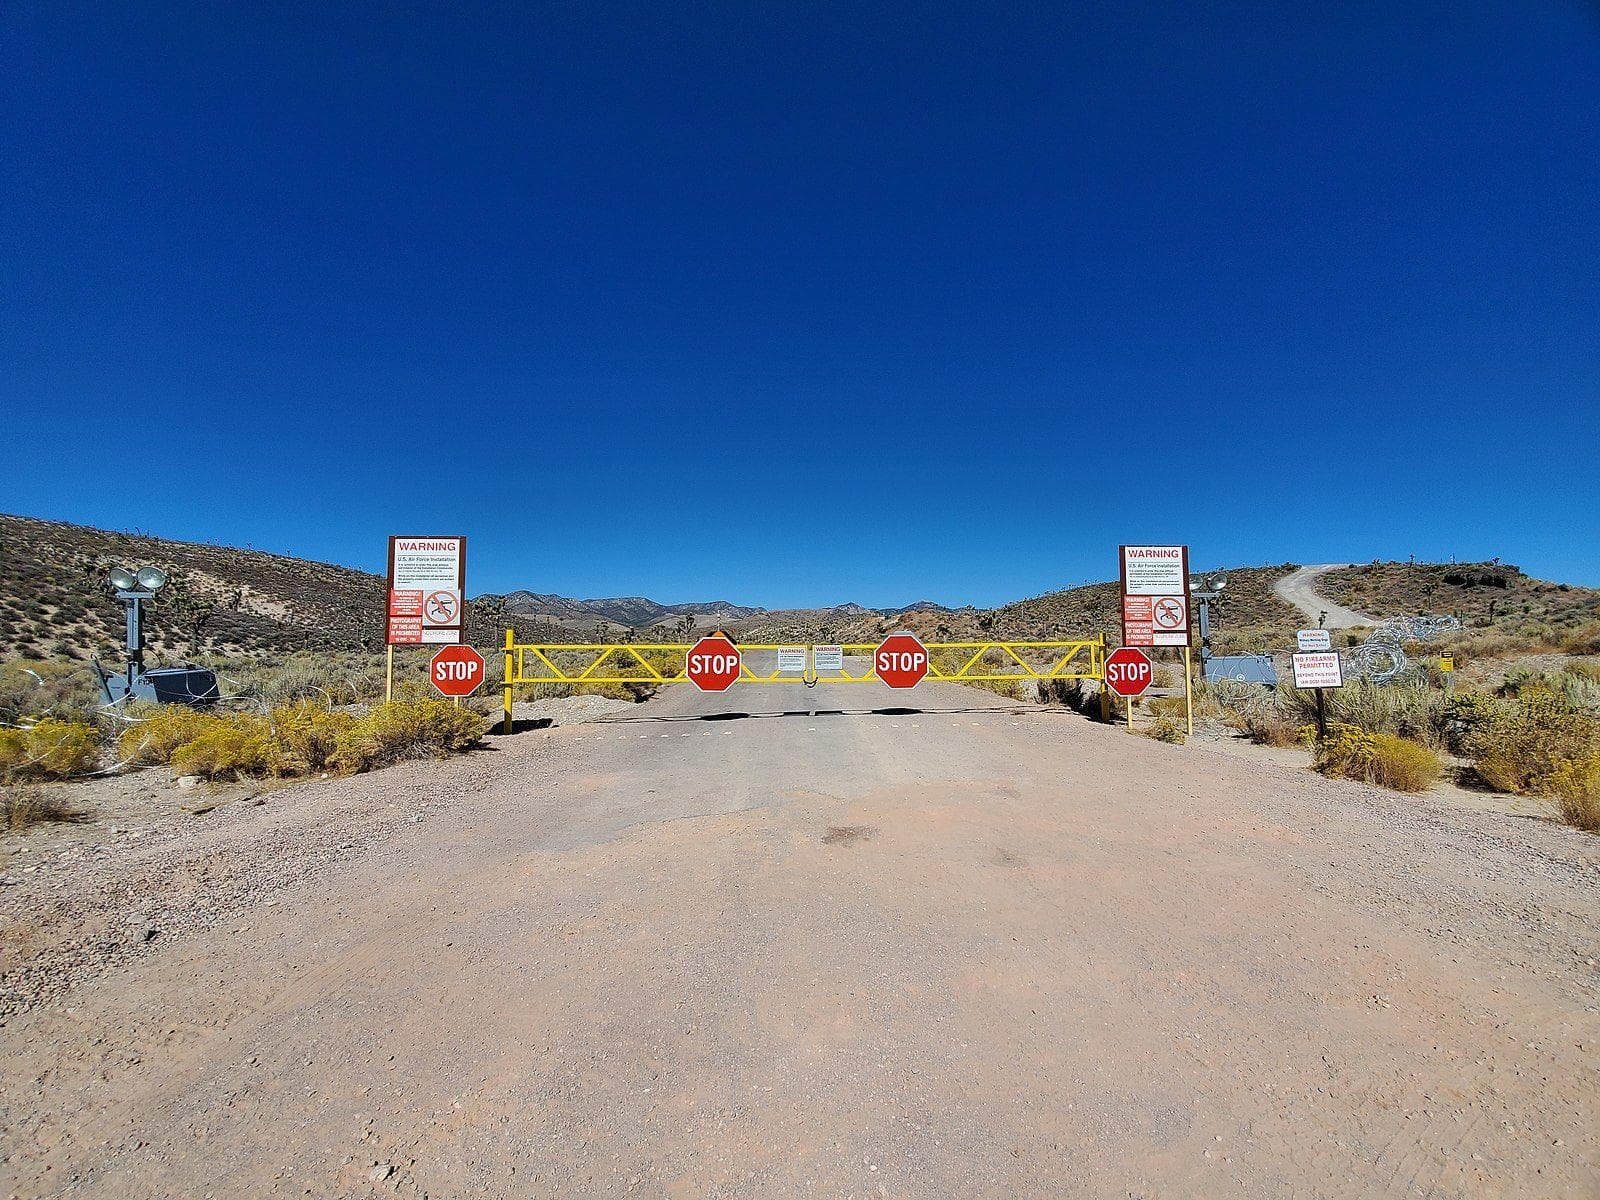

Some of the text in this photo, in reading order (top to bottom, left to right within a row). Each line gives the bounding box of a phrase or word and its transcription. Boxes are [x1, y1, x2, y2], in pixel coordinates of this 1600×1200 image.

[399, 542, 456, 551] WARNING
[1128, 549, 1179, 558] WARNING
[436, 661, 478, 681] STOP
[690, 654, 738, 675] STOP
[878, 652, 925, 672] STOP
[1108, 662, 1149, 682] STOP
